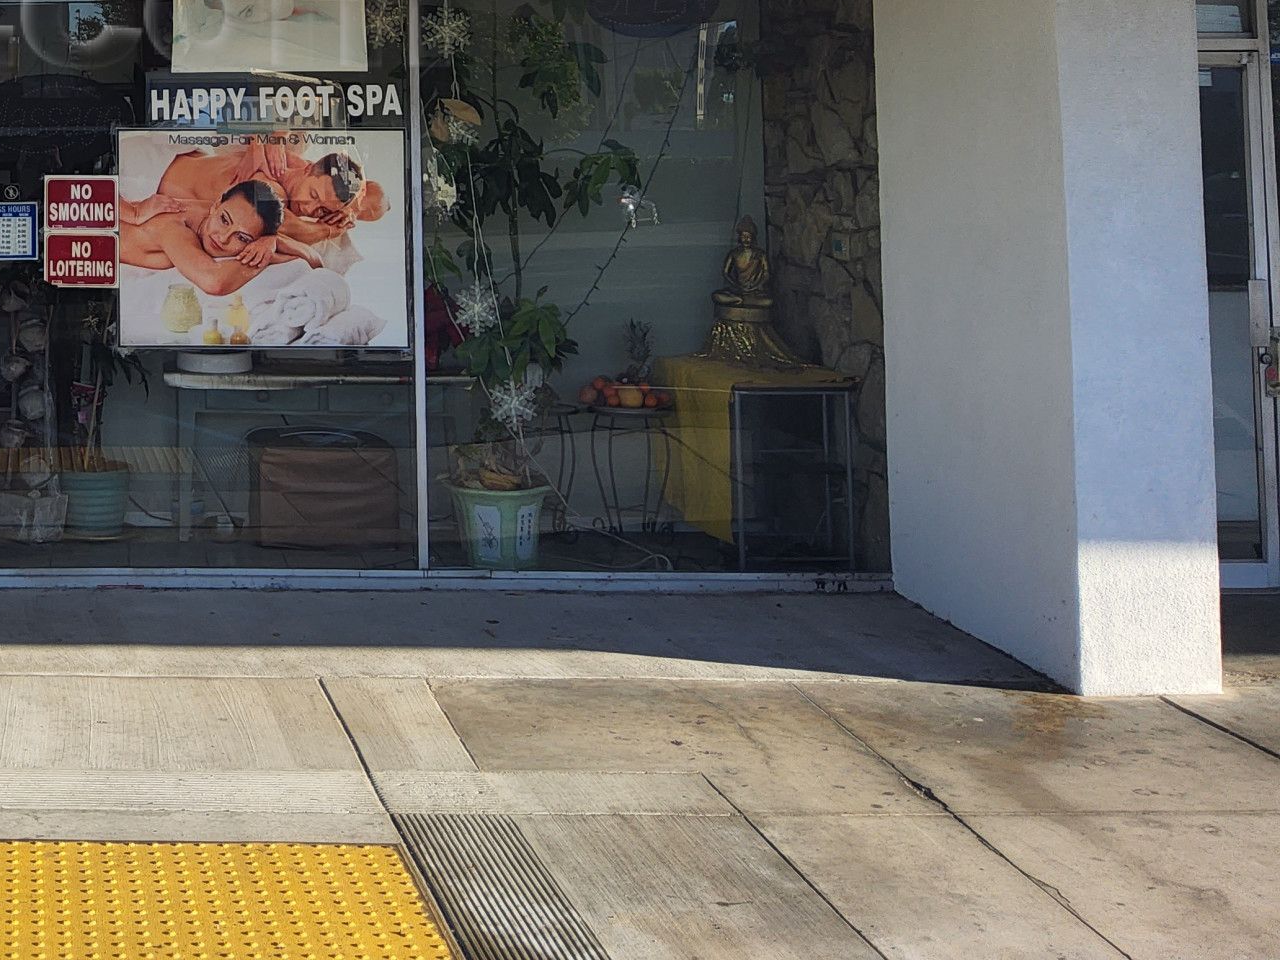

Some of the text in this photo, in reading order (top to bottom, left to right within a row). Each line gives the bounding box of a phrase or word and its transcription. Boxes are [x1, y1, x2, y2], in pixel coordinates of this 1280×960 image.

[150, 83, 403, 121] HAPPY FOOT SPA
[168, 134, 228, 147] Massage
[70, 184, 92, 200] NO
[8, 205, 31, 214] HOURS
[49, 203, 114, 222] SMOKING
[71, 241, 92, 258] NO
[49, 260, 114, 278] LOITERING
